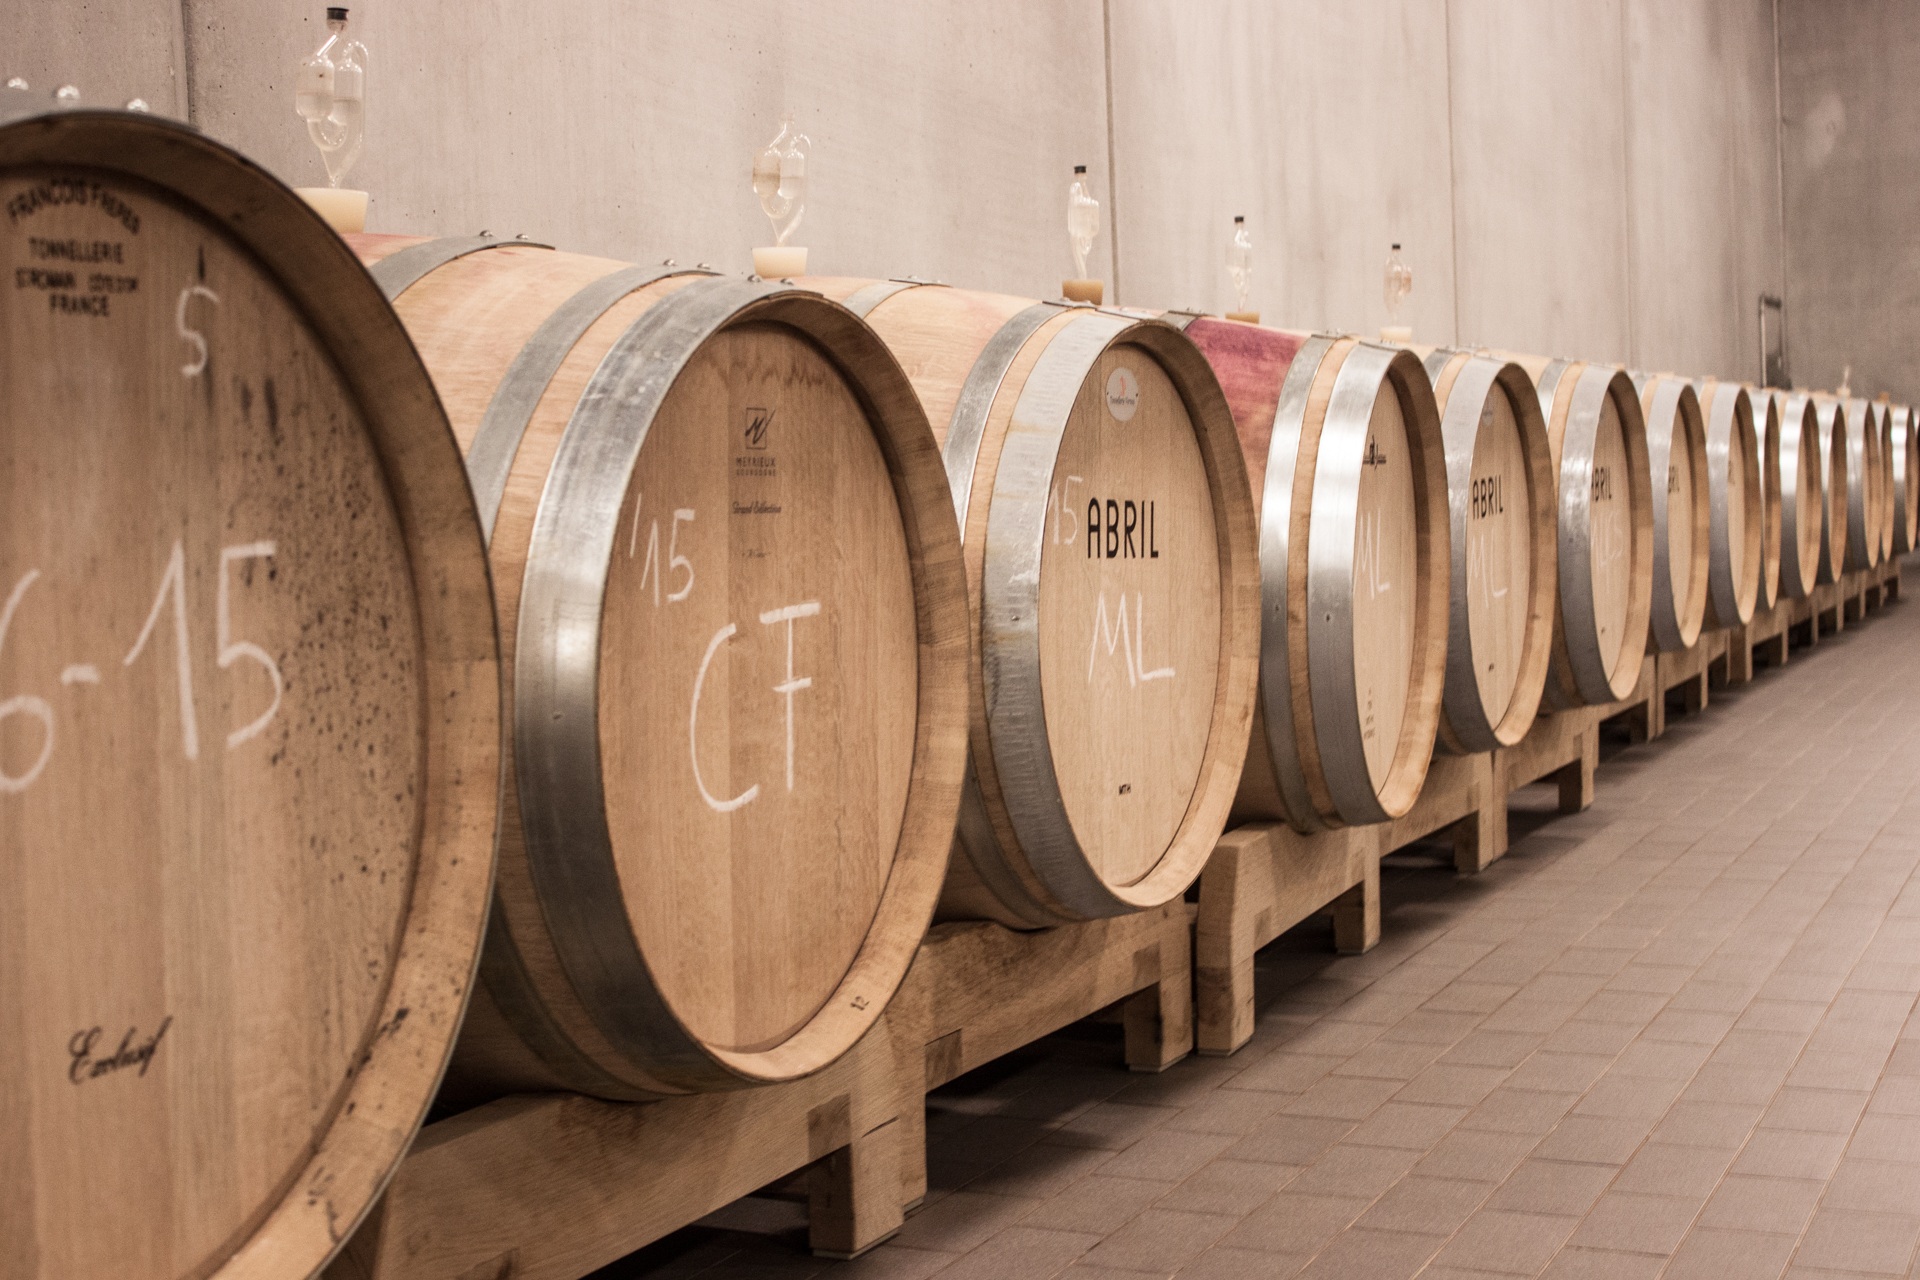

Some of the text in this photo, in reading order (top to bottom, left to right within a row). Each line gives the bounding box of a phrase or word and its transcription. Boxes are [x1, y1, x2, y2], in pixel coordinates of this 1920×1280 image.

[49, 294, 110, 318] FRANCE
[1087, 497, 1159, 559] ABRIL
[1472, 474, 1504, 520] ABRIL
[1353, 507, 1391, 601] ML
[1467, 527, 1508, 609] ML
[1087, 590, 1176, 689] ML
